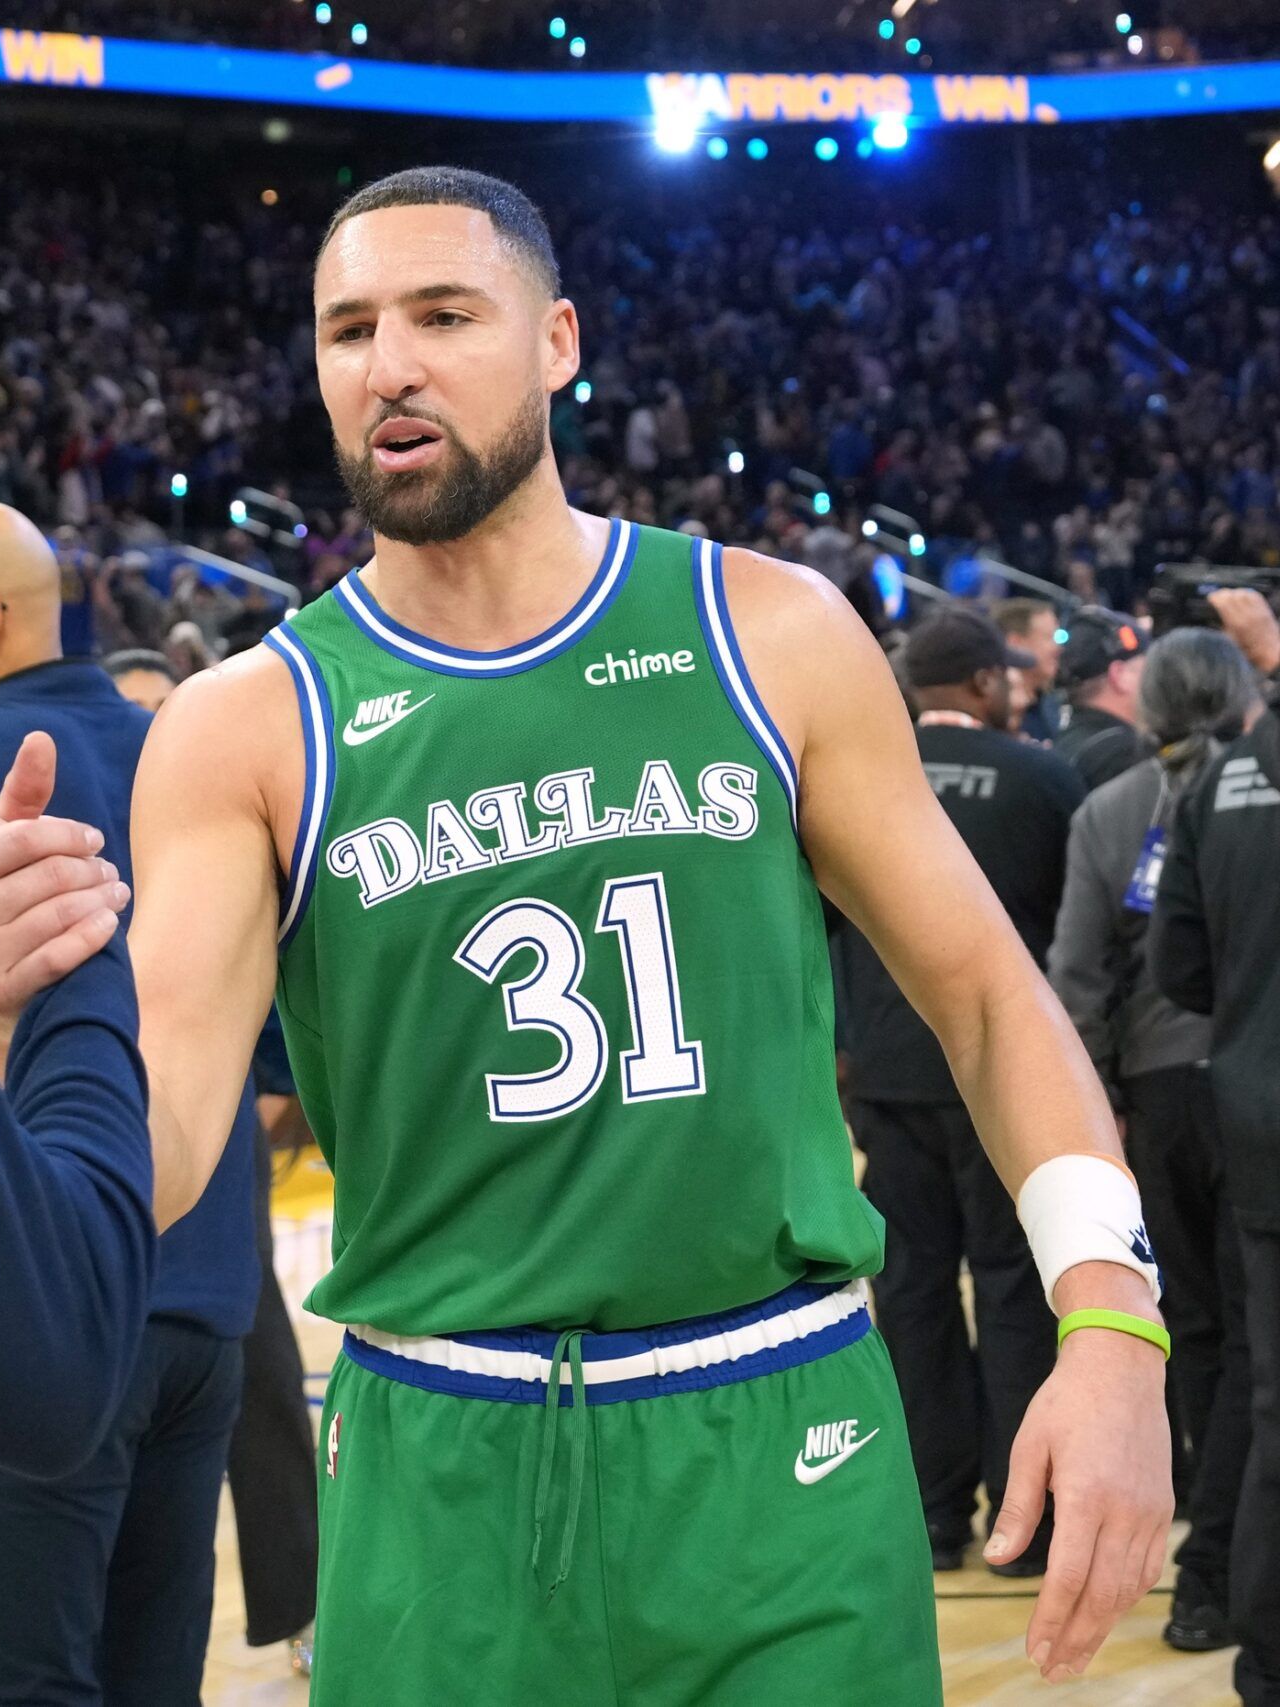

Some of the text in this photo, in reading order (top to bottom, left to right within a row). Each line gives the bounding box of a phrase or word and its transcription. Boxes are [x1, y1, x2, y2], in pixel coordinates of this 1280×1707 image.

[0, 28, 103, 87] WIN
[645, 73, 1029, 121] WARRIORS WIN
[584, 648, 696, 686] chime
[352, 689, 412, 727] NIKE
[922, 761, 998, 799] PN
[326, 760, 759, 910] DALLAS
[452, 871, 707, 1123] 31
[804, 1419, 858, 1461] NIKE
